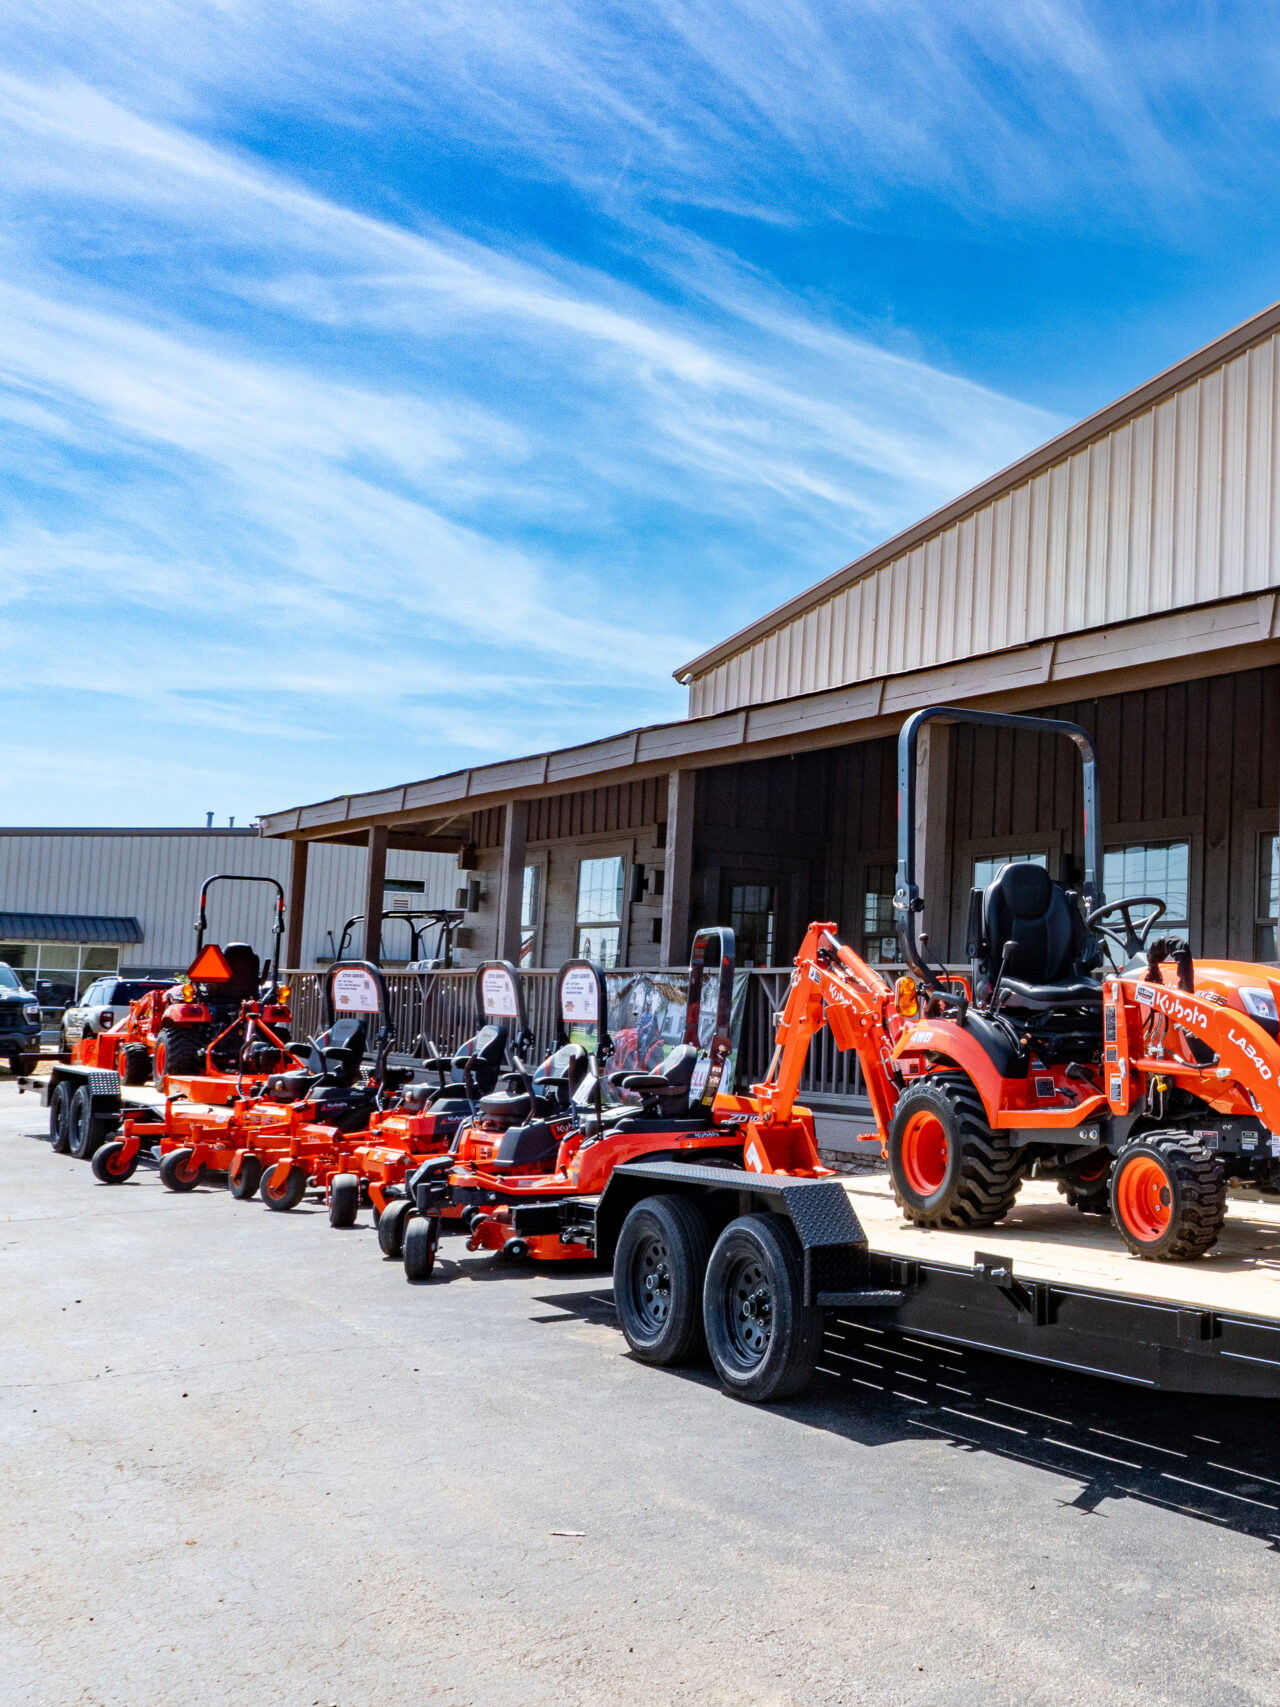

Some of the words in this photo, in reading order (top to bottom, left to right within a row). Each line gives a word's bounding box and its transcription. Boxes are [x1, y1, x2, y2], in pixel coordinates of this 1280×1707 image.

[1155, 992, 1208, 1029] Kubota
[910, 1032, 934, 1043] 4WD
[1227, 1028, 1272, 1081] LA340
[728, 1113, 760, 1123] ZD10
